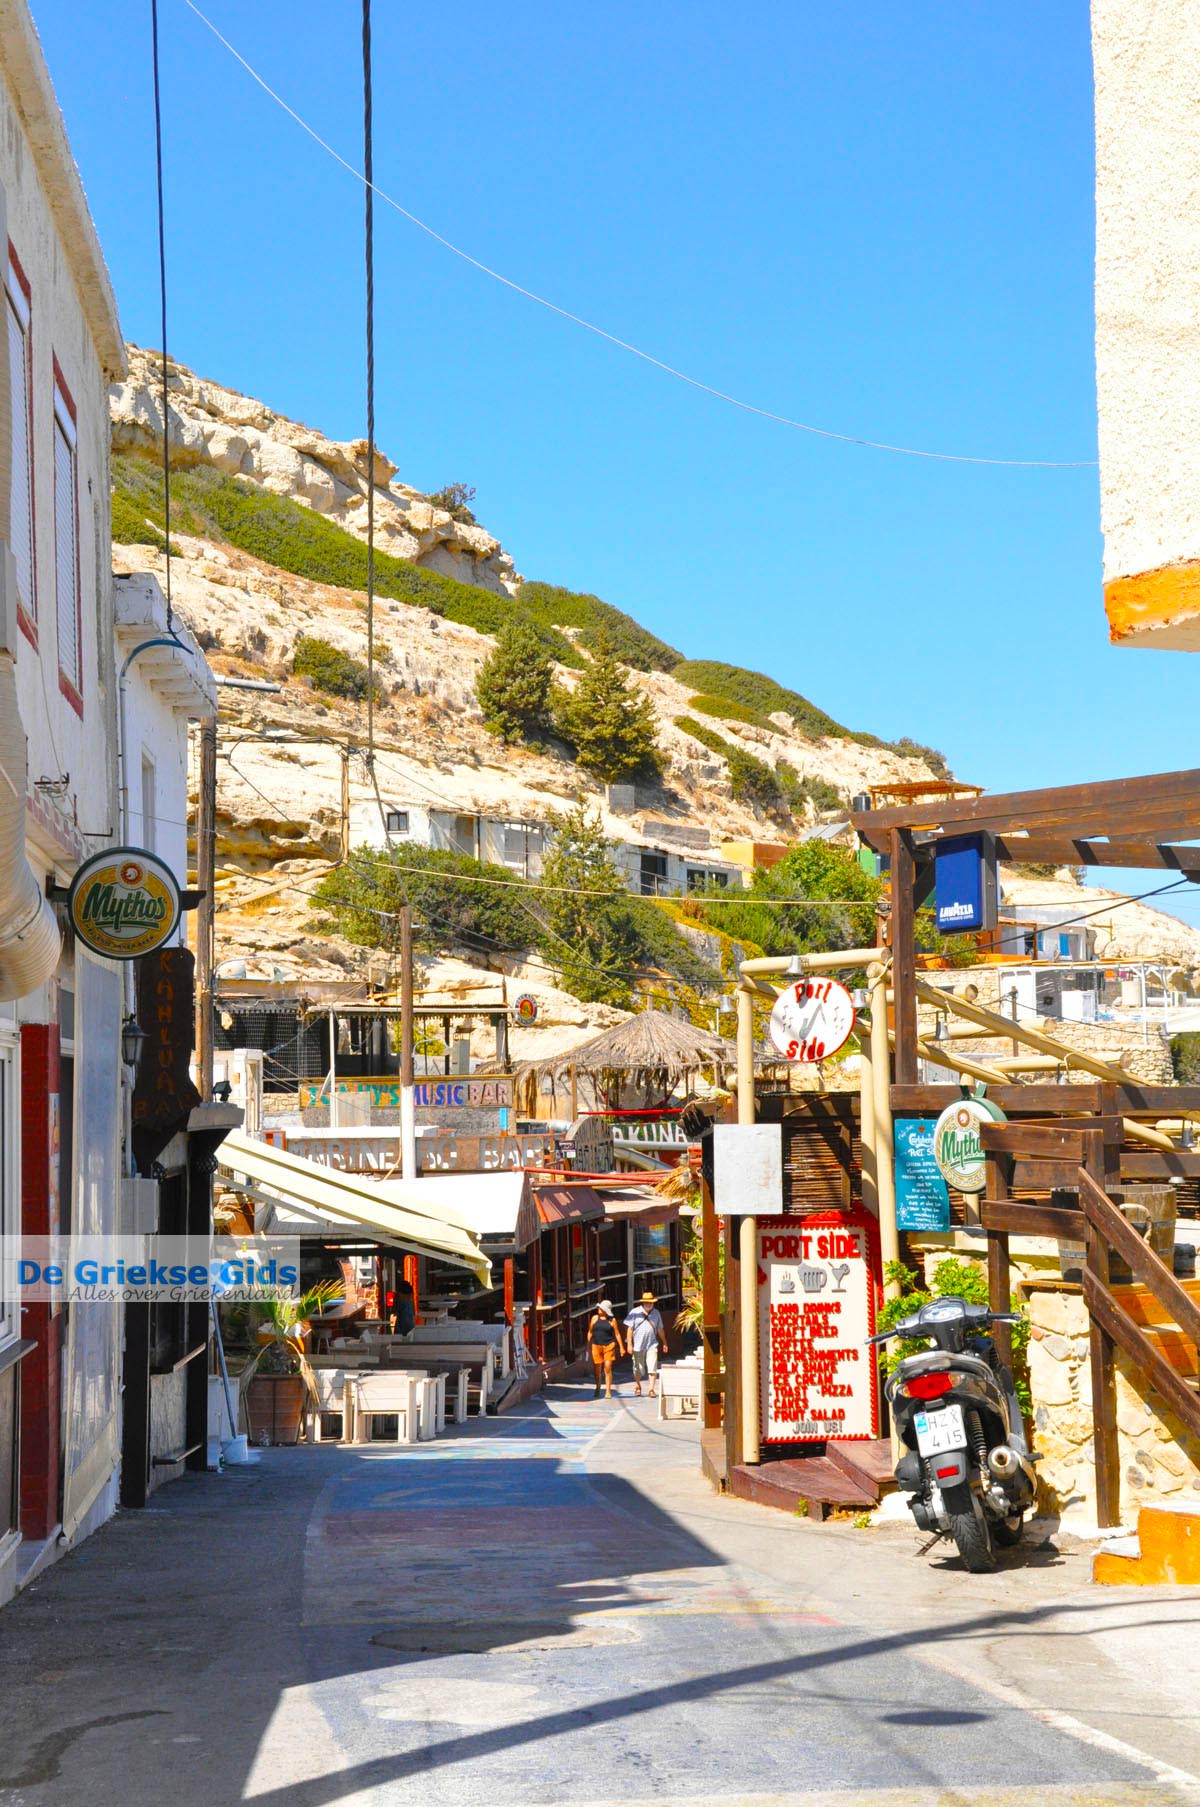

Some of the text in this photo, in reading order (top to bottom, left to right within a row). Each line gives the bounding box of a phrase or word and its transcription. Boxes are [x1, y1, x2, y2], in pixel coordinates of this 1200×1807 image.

[82, 882, 166, 931] Mythos
[939, 902, 974, 918] LAVAZZA
[156, 951, 177, 1096] KAHLUA
[307, 1085, 401, 1107] TY'S
[468, 1083, 508, 1106] BAR
[612, 1121, 688, 1143] AKUNA
[480, 1137, 543, 1169] BAR
[941, 1130, 985, 1169] Myth
[761, 1231, 861, 1260] PORT SIDE
[770, 1302, 841, 1314] LONG DRINKS
[771, 1314, 829, 1327] COCKTAILS
[772, 1325, 839, 1339] DRAFT BEER
[772, 1339, 815, 1351] COFFEE
[772, 1349, 859, 1362] REFRESHMENTS
[773, 1361, 838, 1374] MILK SHAKE
[773, 1372, 833, 1386] ICE CREAM
[774, 1384, 853, 1398] TOAST PIZZA
[774, 1398, 809, 1410] CAKES
[774, 1408, 846, 1422] FRUIT SALAD
[793, 1420, 843, 1434] JOIN US!
[932, 1429, 963, 1448] 415
